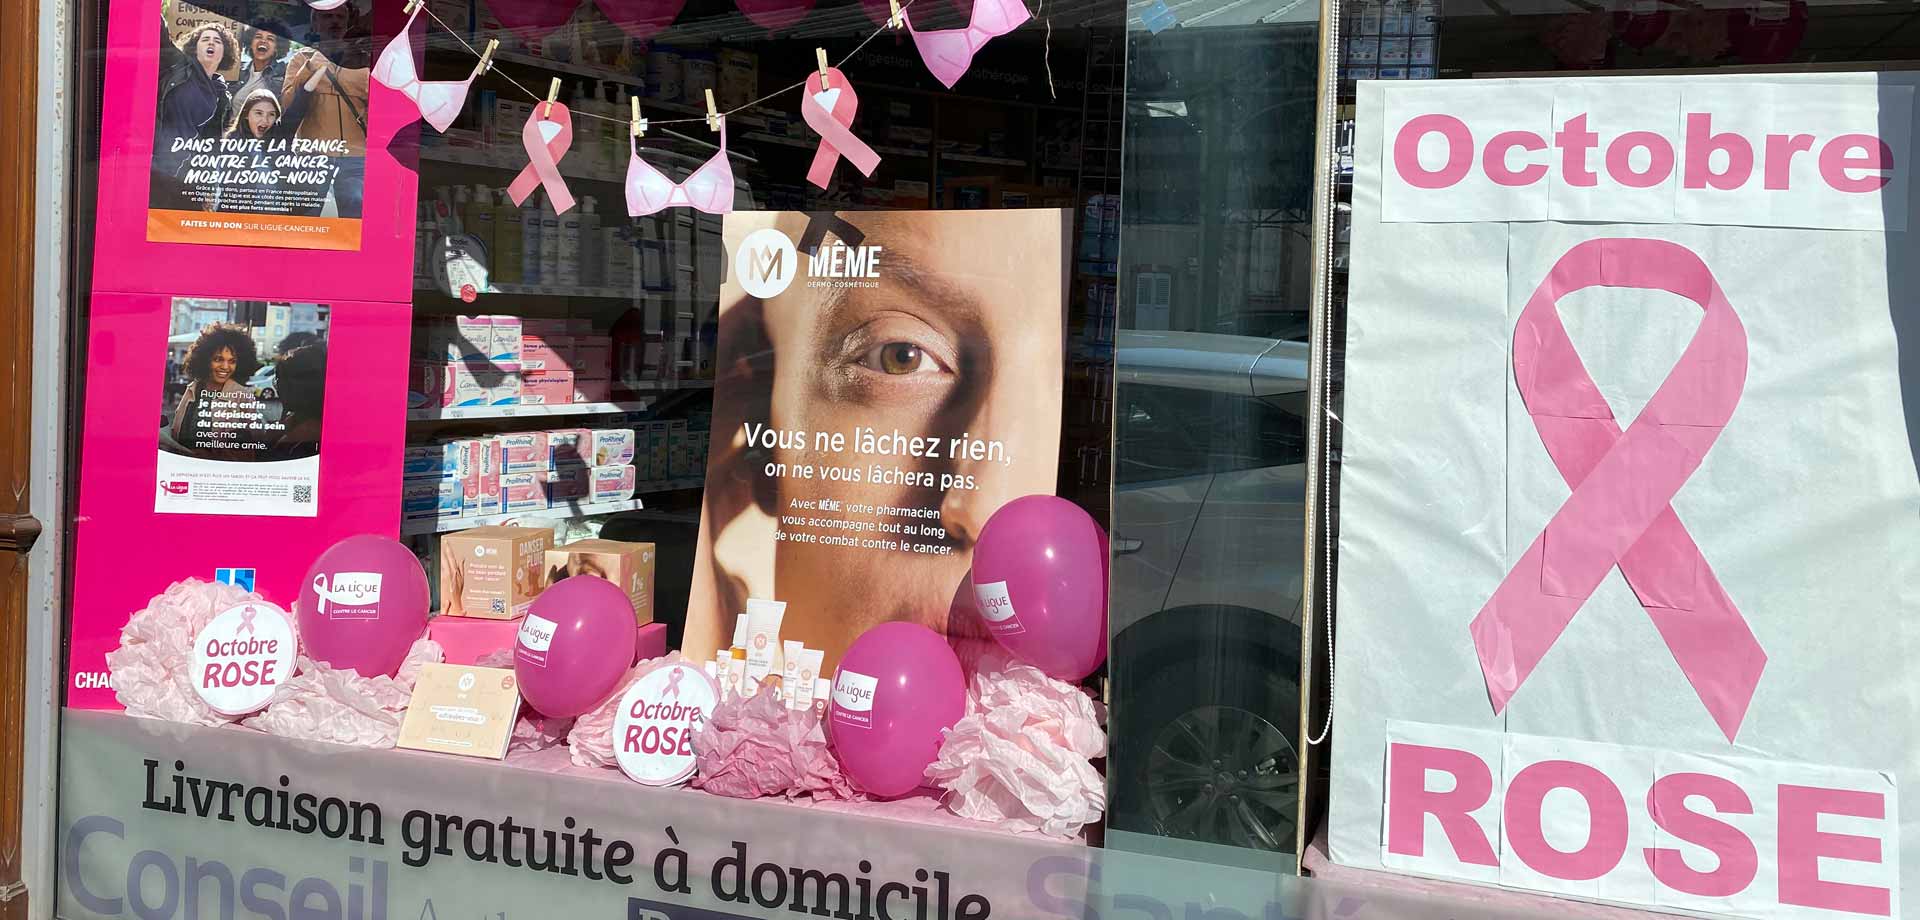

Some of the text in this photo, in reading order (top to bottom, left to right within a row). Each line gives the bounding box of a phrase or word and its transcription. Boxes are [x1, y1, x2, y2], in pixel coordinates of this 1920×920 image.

[171, 137, 350, 154] DANS TOUTE LA FRANCE,
[1393, 112, 1895, 194] Octobre
[190, 154, 335, 170] CONTRE LE CANCER,
[181, 219, 208, 228] FAITES
[209, 221, 222, 229] UN
[243, 222, 259, 230] SUR
[260, 223, 330, 233] LIGUE-CANCER.NET
[807, 239, 882, 278] MÊME
[807, 281, 880, 289] DERMO-COSMÉTIQUE
[197, 399, 266, 410] je parle enfin
[200, 389, 256, 400] Aujourd'hui,
[197, 419, 211, 428] du
[249, 421, 263, 430] du
[264, 421, 285, 430] sein
[198, 409, 264, 421] du dépistage
[195, 440, 268, 450] meilleure amie.
[220, 431, 237, 439] ma
[744, 422, 1011, 467] Vous ne lâchez rien,
[765, 462, 980, 492] on ne vous lâchera pas.
[790, 498, 816, 510] Avec
[846, 502, 873, 514] votre
[876, 504, 940, 520] pharmacien
[782, 515, 946, 539] vous accompagne tout au long
[774, 530, 954, 555] de votre combat contre le cancer.
[334, 584, 346, 593] LA
[206, 636, 278, 658] Octobre
[74, 671, 113, 689] CHA
[203, 659, 278, 689] ROSE
[630, 699, 701, 722] Octobre
[623, 724, 692, 756] ROSE
[142, 758, 385, 845] Livraison
[401, 809, 635, 885] gratuite
[653, 825, 692, 895] à
[710, 840, 992, 920] domicile
[1387, 742, 1892, 917] ROSE
